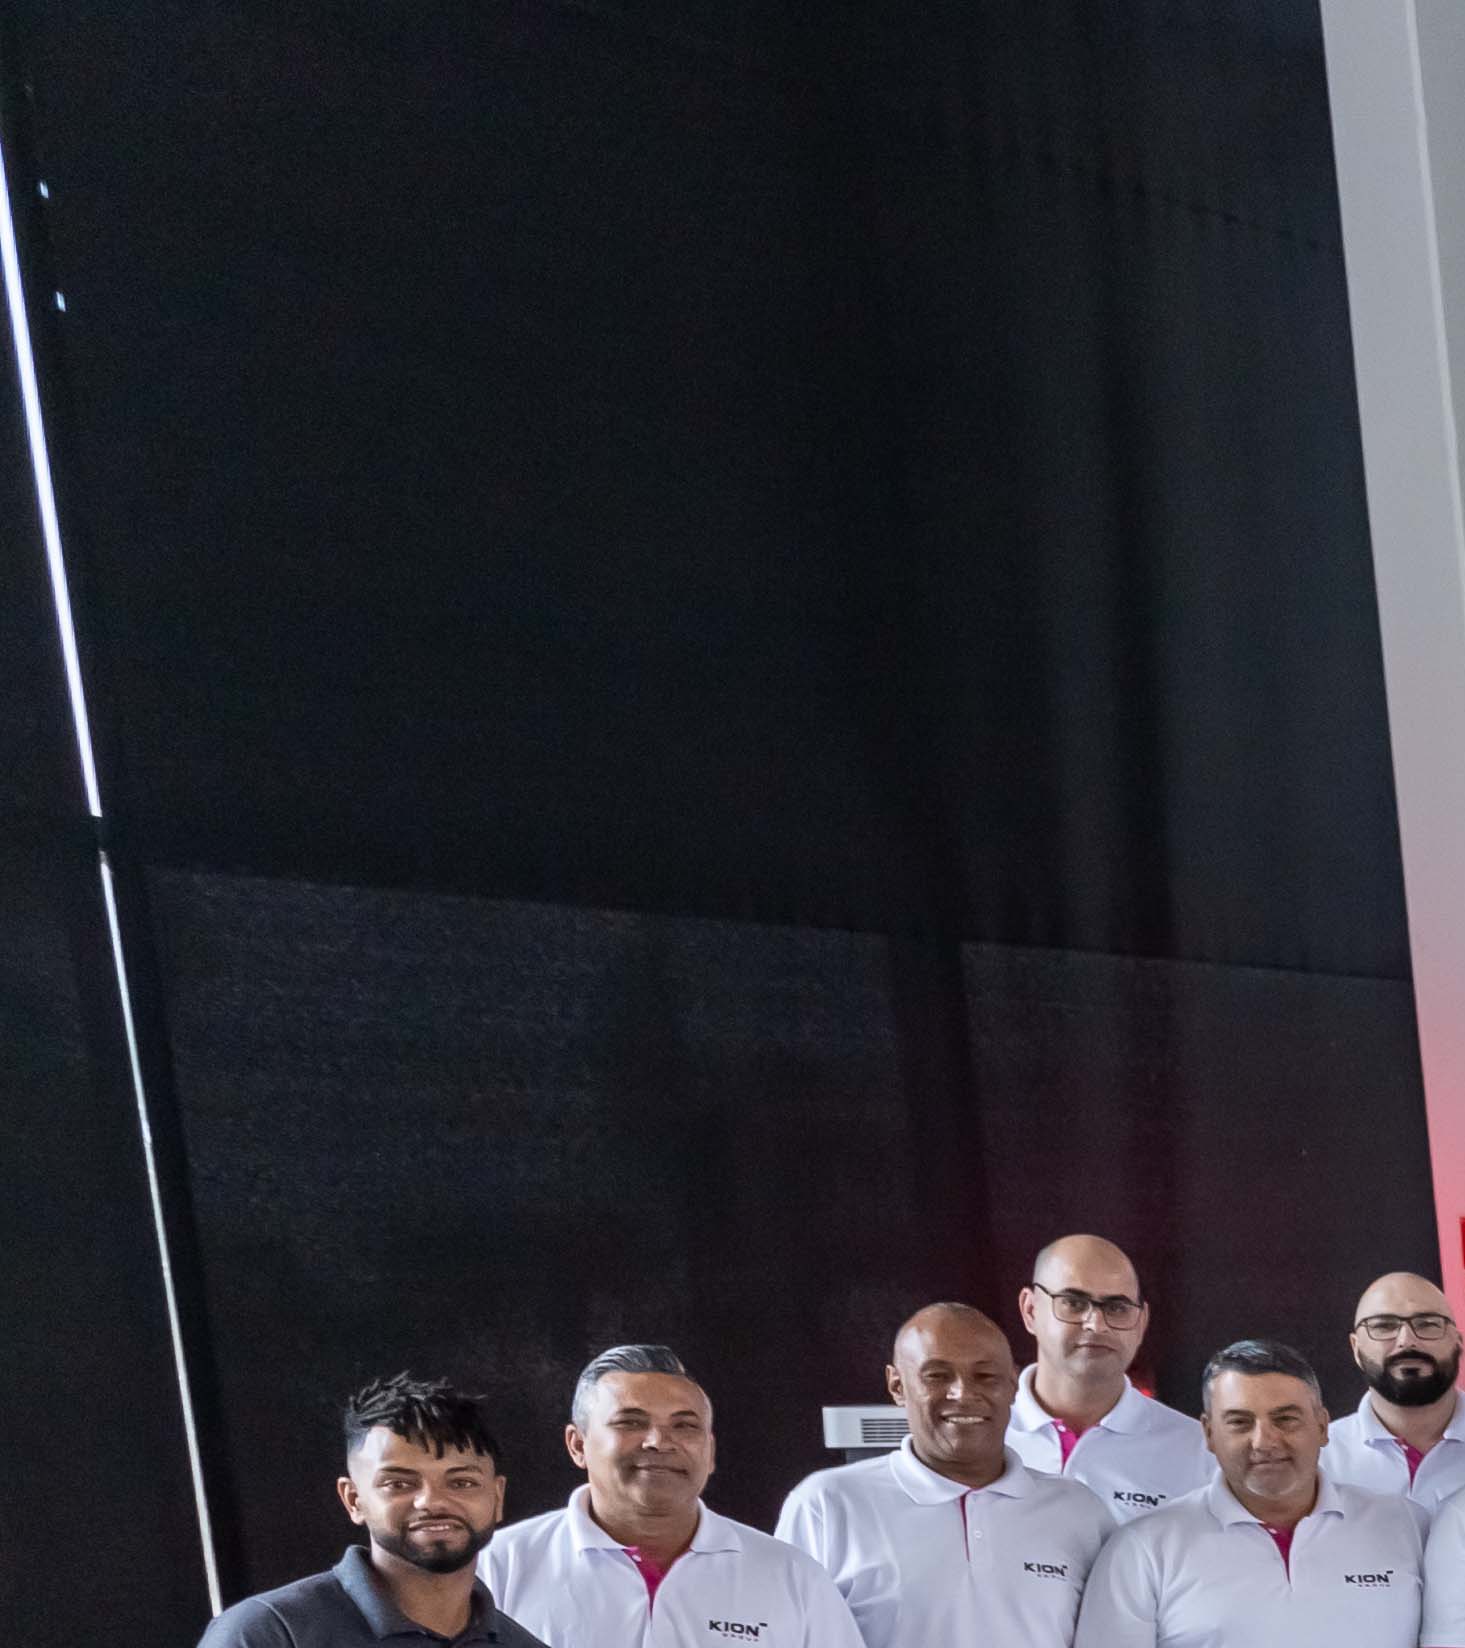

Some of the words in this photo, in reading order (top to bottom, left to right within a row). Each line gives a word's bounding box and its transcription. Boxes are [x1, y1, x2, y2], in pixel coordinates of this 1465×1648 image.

[1113, 1491, 1159, 1506] KION
[1024, 1562, 1066, 1577] KION
[1345, 1573, 1390, 1583] KION
[709, 1620, 760, 1637] KION
